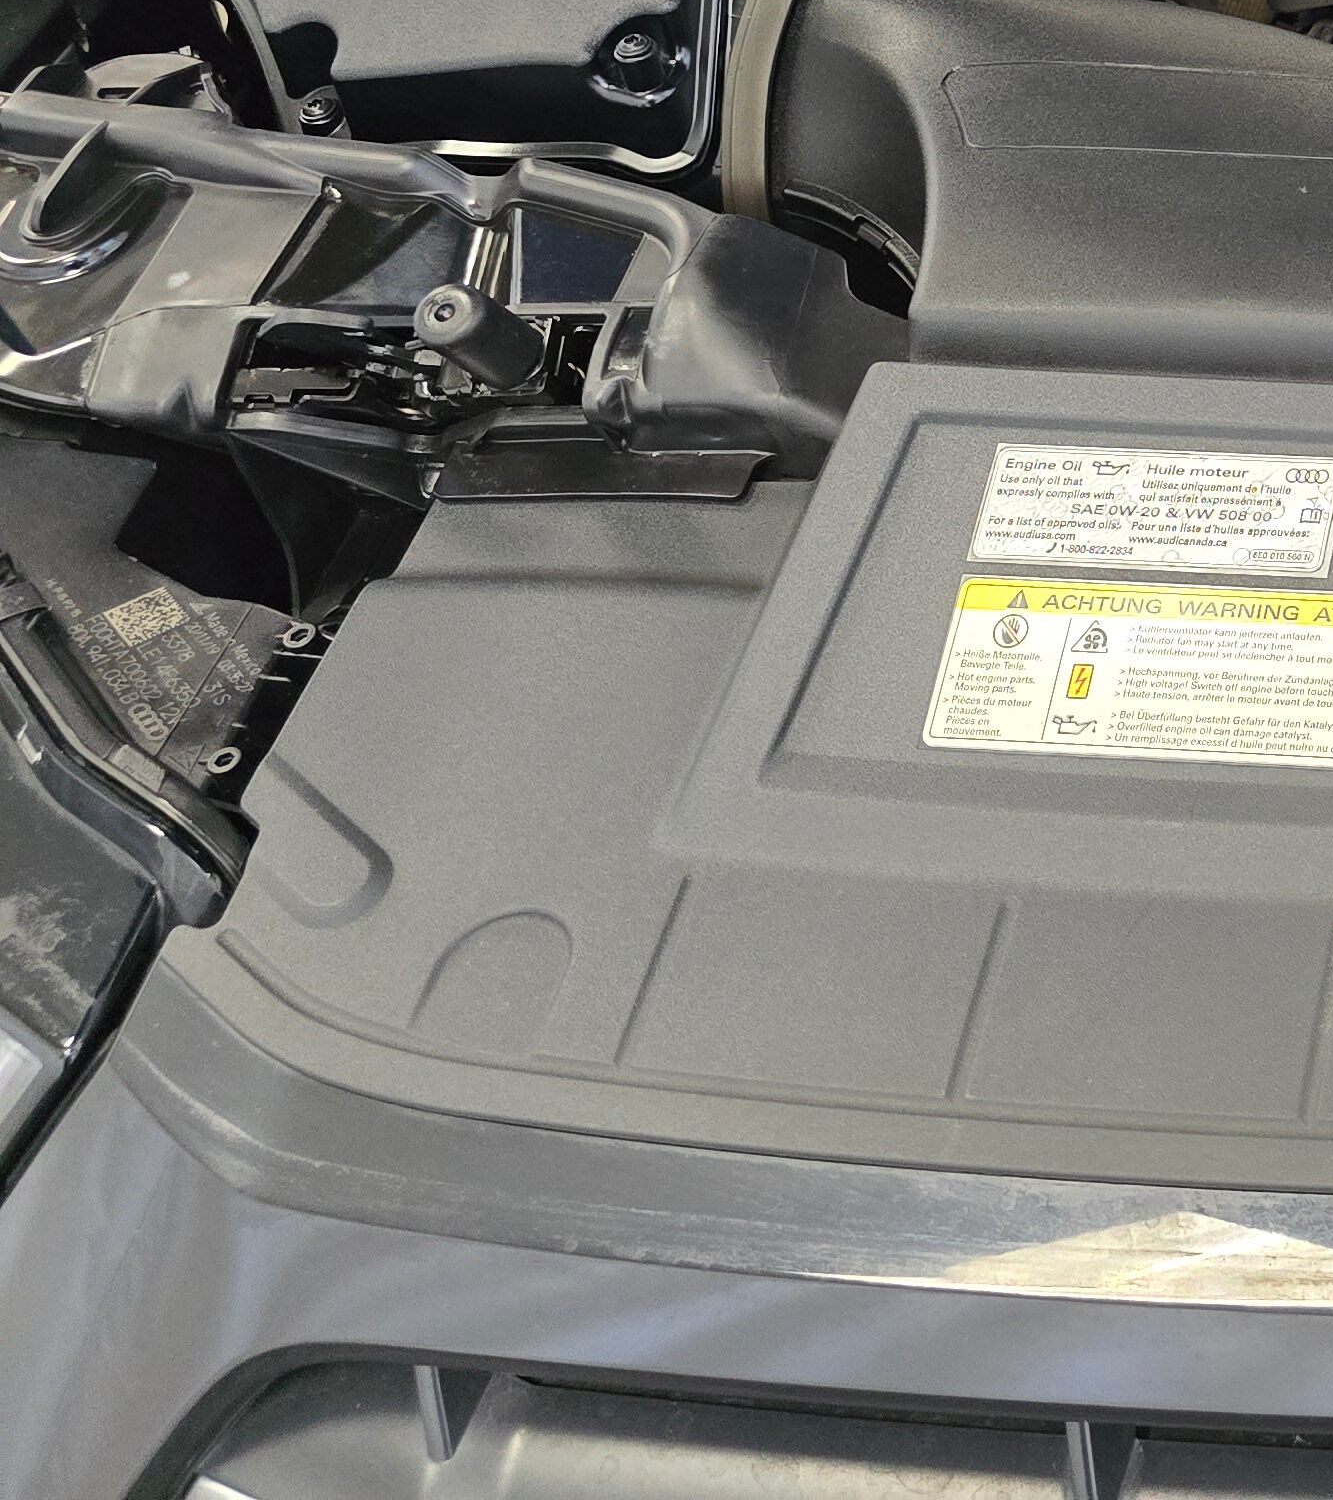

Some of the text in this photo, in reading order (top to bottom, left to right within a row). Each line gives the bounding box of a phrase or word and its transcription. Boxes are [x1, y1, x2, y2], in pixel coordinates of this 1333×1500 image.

[1005, 458, 1082, 472] Engine Oil
[1147, 464, 1249, 478] Huile moteur
[1000, 474, 1083, 486] Use only oil that
[1142, 479, 1179, 490] Utilisez
[1181, 481, 1242, 494] uniquement
[1245, 483, 1258, 494] de
[997, 487, 1115, 500] expressly complies with
[1139, 492, 1156, 503] qui
[1158, 493, 1199, 505] satisfait
[1070, 503, 1272, 522] SAE 0W-20 & VW 508 00
[988, 515, 1006, 525] For
[1007, 518, 1014, 526] a
[1016, 516, 1032, 526] list
[1034, 517, 1047, 529] of
[1047, 519, 1096, 529] approved
[1131, 521, 1156, 531] Pour
[1180, 522, 1202, 533] liste
[985, 530, 1076, 541] www.audiusa.com
[1129, 535, 1227, 547] www.audicanada.ca
[1041, 594, 1162, 613] ACHTUNG
[1179, 601, 1299, 620] WARNING
[162, 631, 196, 664] 3378
[204, 612, 228, 638] Made
[230, 644, 262, 676] Mexico
[957, 672, 974, 681] Hot
[975, 675, 1008, 684] engine
[1203, 672, 1219, 680] vor
[203, 681, 232, 705] 31S
[954, 682, 990, 694] Moving
[1125, 678, 1148, 688] High
[1190, 681, 1223, 691] Switch
[1240, 685, 1272, 695] engine
[1274, 686, 1305, 695] before
[983, 696, 996, 706] du
[997, 699, 1032, 707] moteur
[1123, 688, 1151, 699] Haute
[1237, 696, 1272, 705] moteur
[1273, 698, 1300, 706] avant
[1302, 698, 1315, 707] de
[1119, 710, 1135, 719] Bei
[1195, 714, 1231, 725] besteht
[1232, 716, 1265, 726] Gefahr
[1283, 719, 1301, 728] den
[1117, 721, 1163, 733] Overfilled
[1165, 725, 1197, 735] engine
[1199, 726, 1212, 735] oil
[1213, 728, 1231, 736] can
[1233, 728, 1272, 740] damage
[1114, 733, 1128, 742] Un
[1190, 738, 1229, 747] excessif
